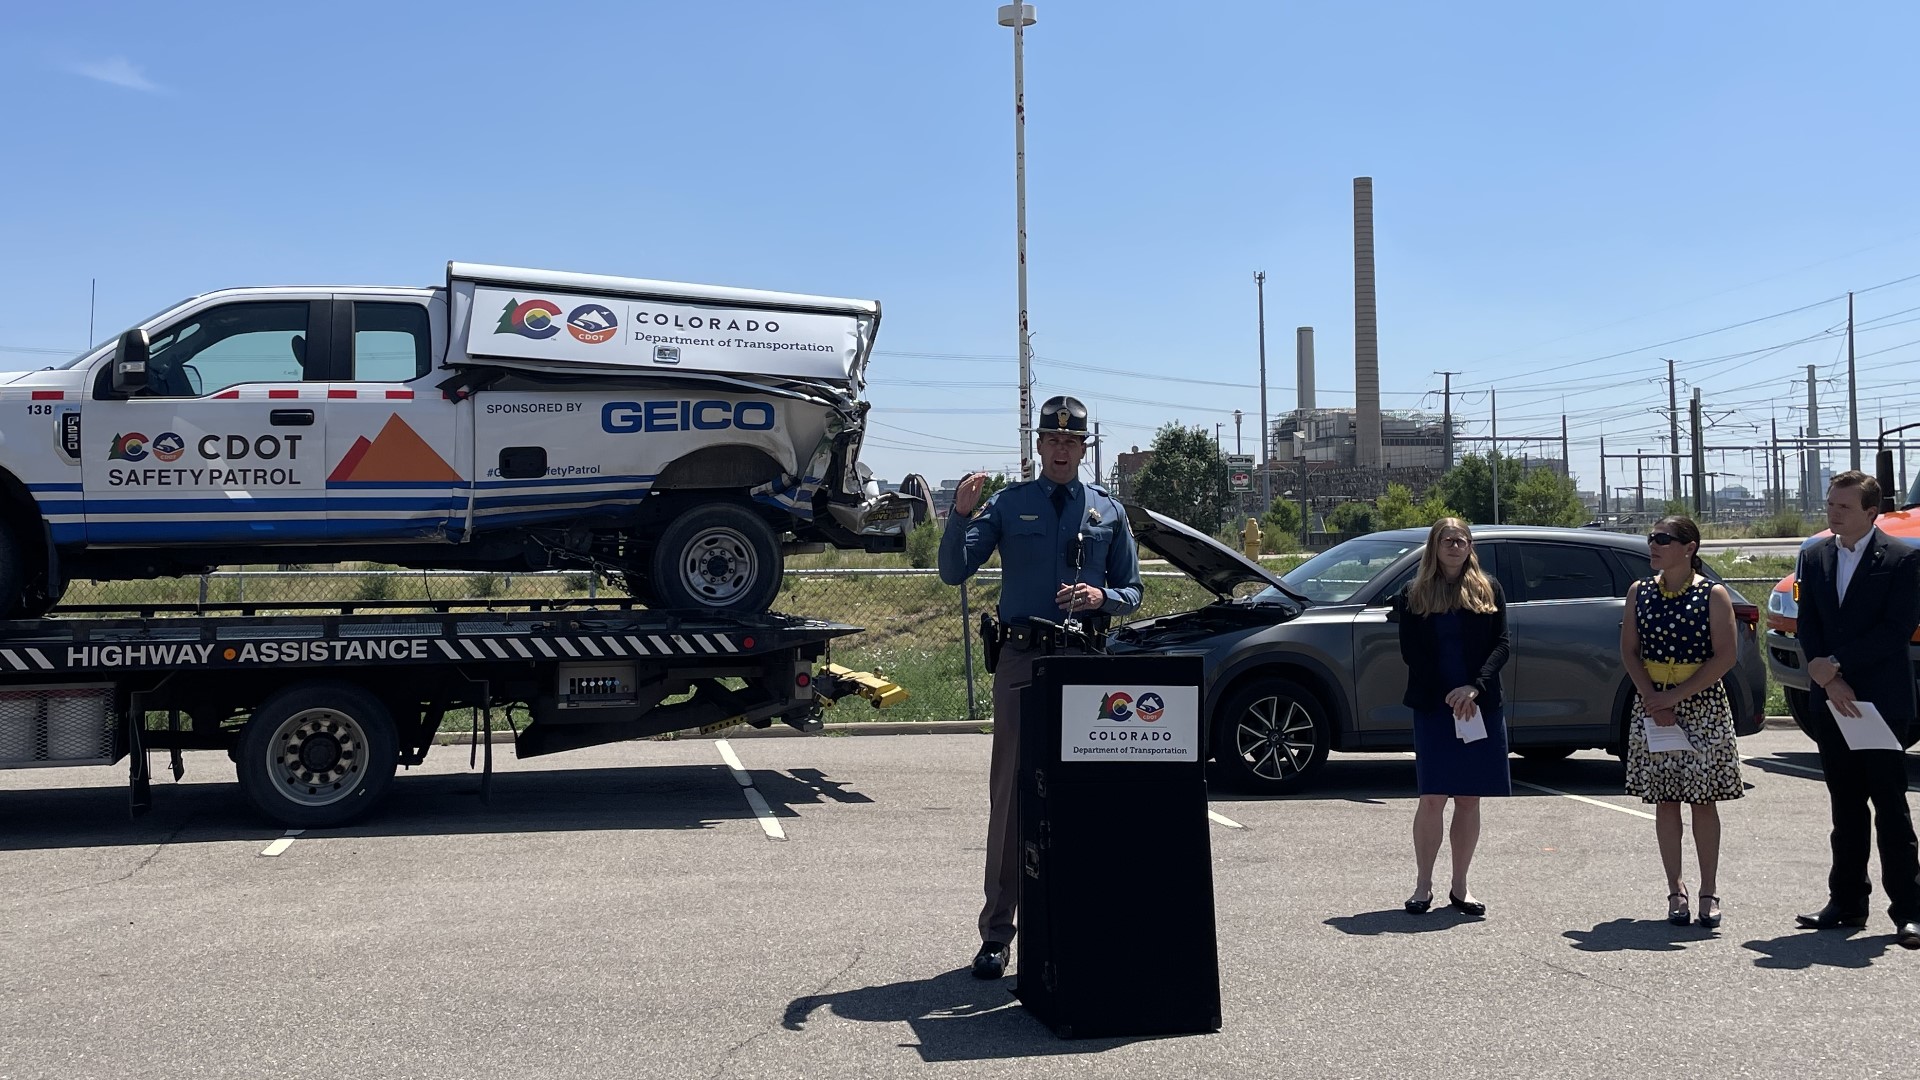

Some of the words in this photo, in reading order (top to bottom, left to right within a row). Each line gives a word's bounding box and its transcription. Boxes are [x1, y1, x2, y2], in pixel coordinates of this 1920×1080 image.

[636, 311, 780, 333] COLORADO
[578, 333, 604, 341] CDOT
[634, 331, 715, 347] Department
[718, 338, 732, 347] of
[734, 338, 835, 353] Transportation
[27, 404, 52, 415] 138
[486, 403, 563, 414] SPONSORED
[566, 402, 582, 412] BY
[601, 400, 775, 433] GEICO
[198, 434, 302, 460] CDOT
[108, 468, 205, 486] SAFETY
[209, 468, 302, 485] PATROL
[67, 643, 215, 667] HIGHWAY
[238, 639, 428, 663] ASSISTANCE
[1089, 731, 1172, 741] COLORADO
[1073, 746, 1119, 755] Department
[1120, 746, 1128, 754] of
[1129, 746, 1188, 755] Transportation
